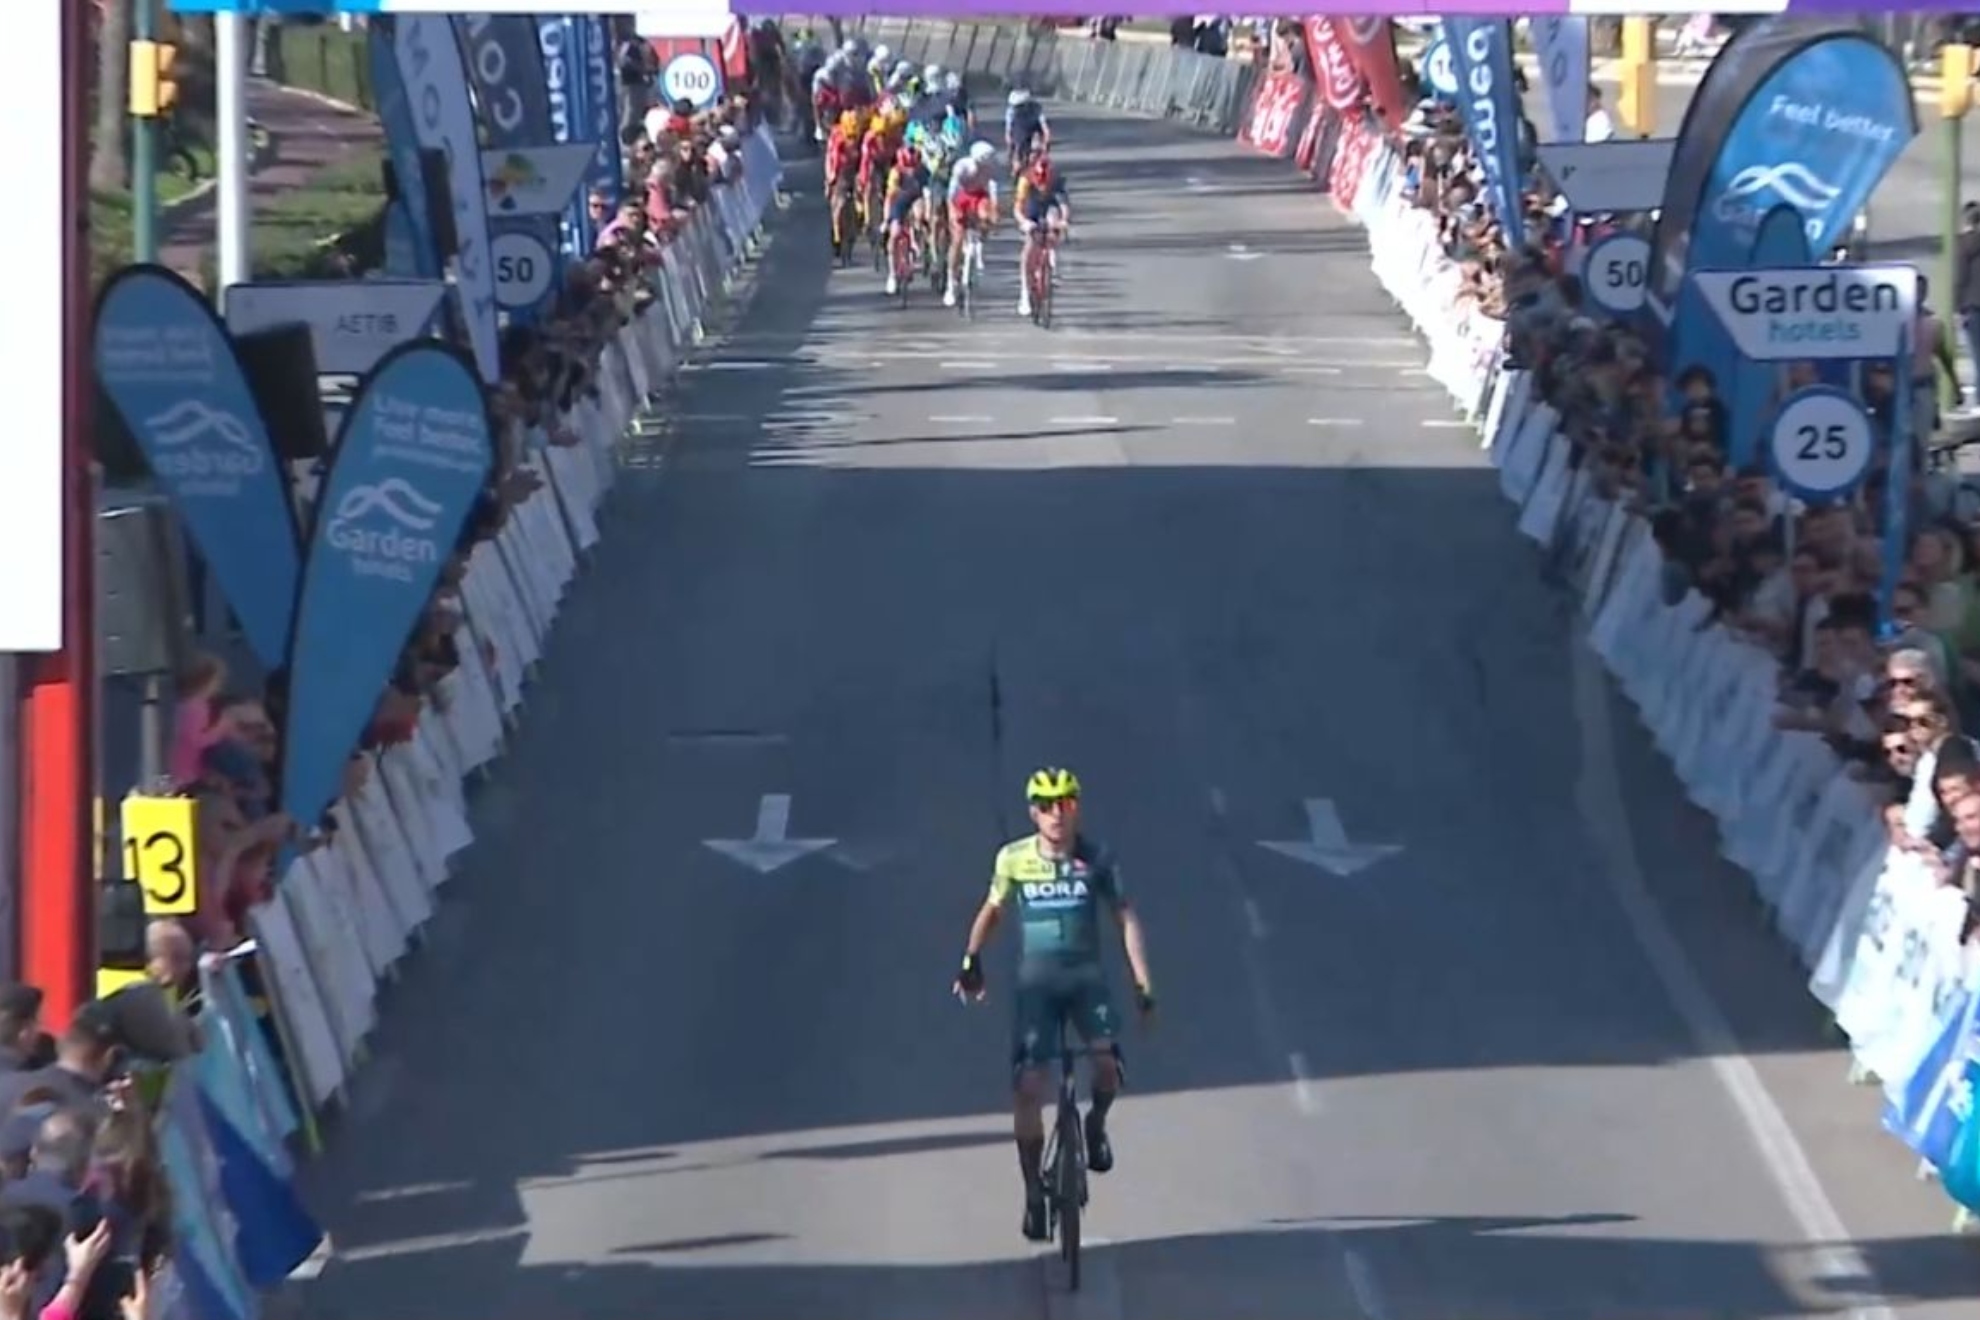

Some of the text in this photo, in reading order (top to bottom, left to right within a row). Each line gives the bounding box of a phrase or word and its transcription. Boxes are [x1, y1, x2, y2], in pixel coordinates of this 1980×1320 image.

[673, 71, 710, 90] 100
[1770, 94, 1894, 141] Feel better
[497, 256, 534, 284] 50
[1607, 260, 1642, 288] 50
[1729, 274, 1899, 314] Garden
[1768, 317, 1860, 342] hotels
[1796, 424, 1848, 460] 25
[327, 518, 438, 562] Garden
[124, 830, 186, 905] 13
[1023, 880, 1089, 900] BORA
